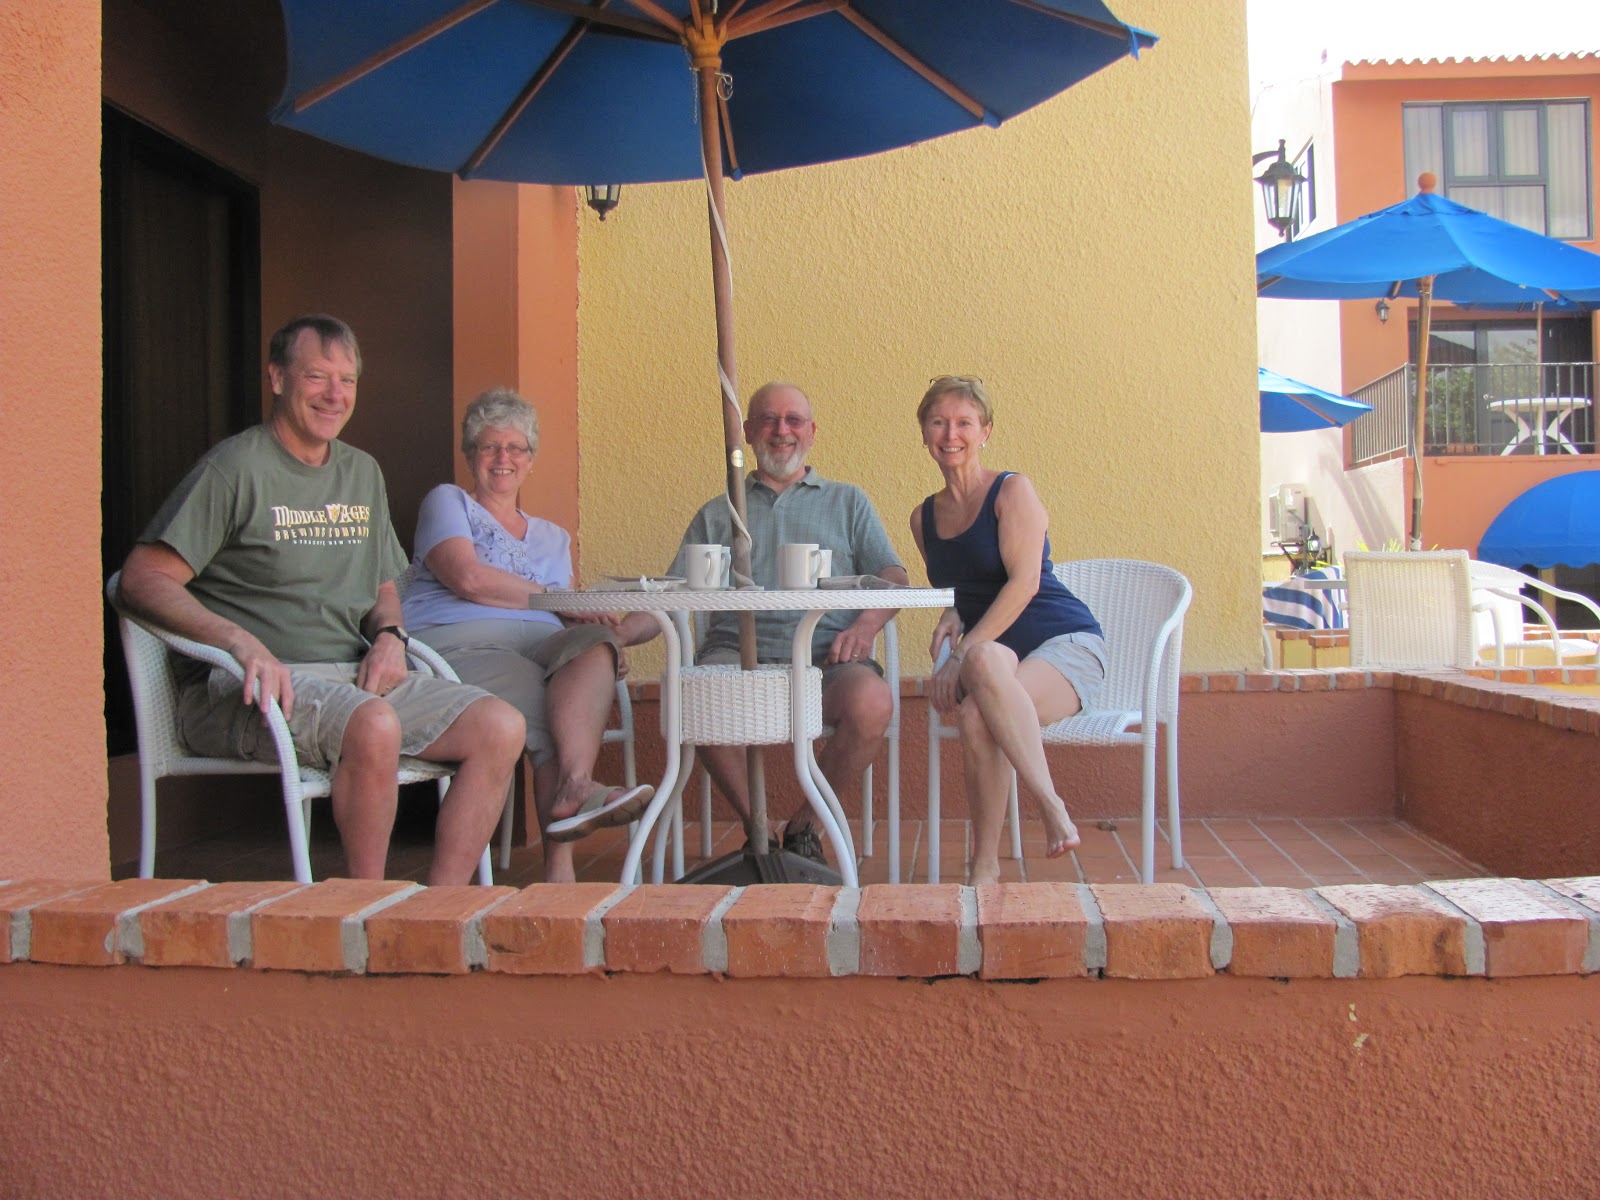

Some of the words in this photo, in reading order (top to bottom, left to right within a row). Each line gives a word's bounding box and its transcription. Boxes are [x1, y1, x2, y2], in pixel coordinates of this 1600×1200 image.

[271, 506, 328, 527] MIDDLE
[339, 504, 370, 523] AGES
[274, 528, 326, 541] BREWING
